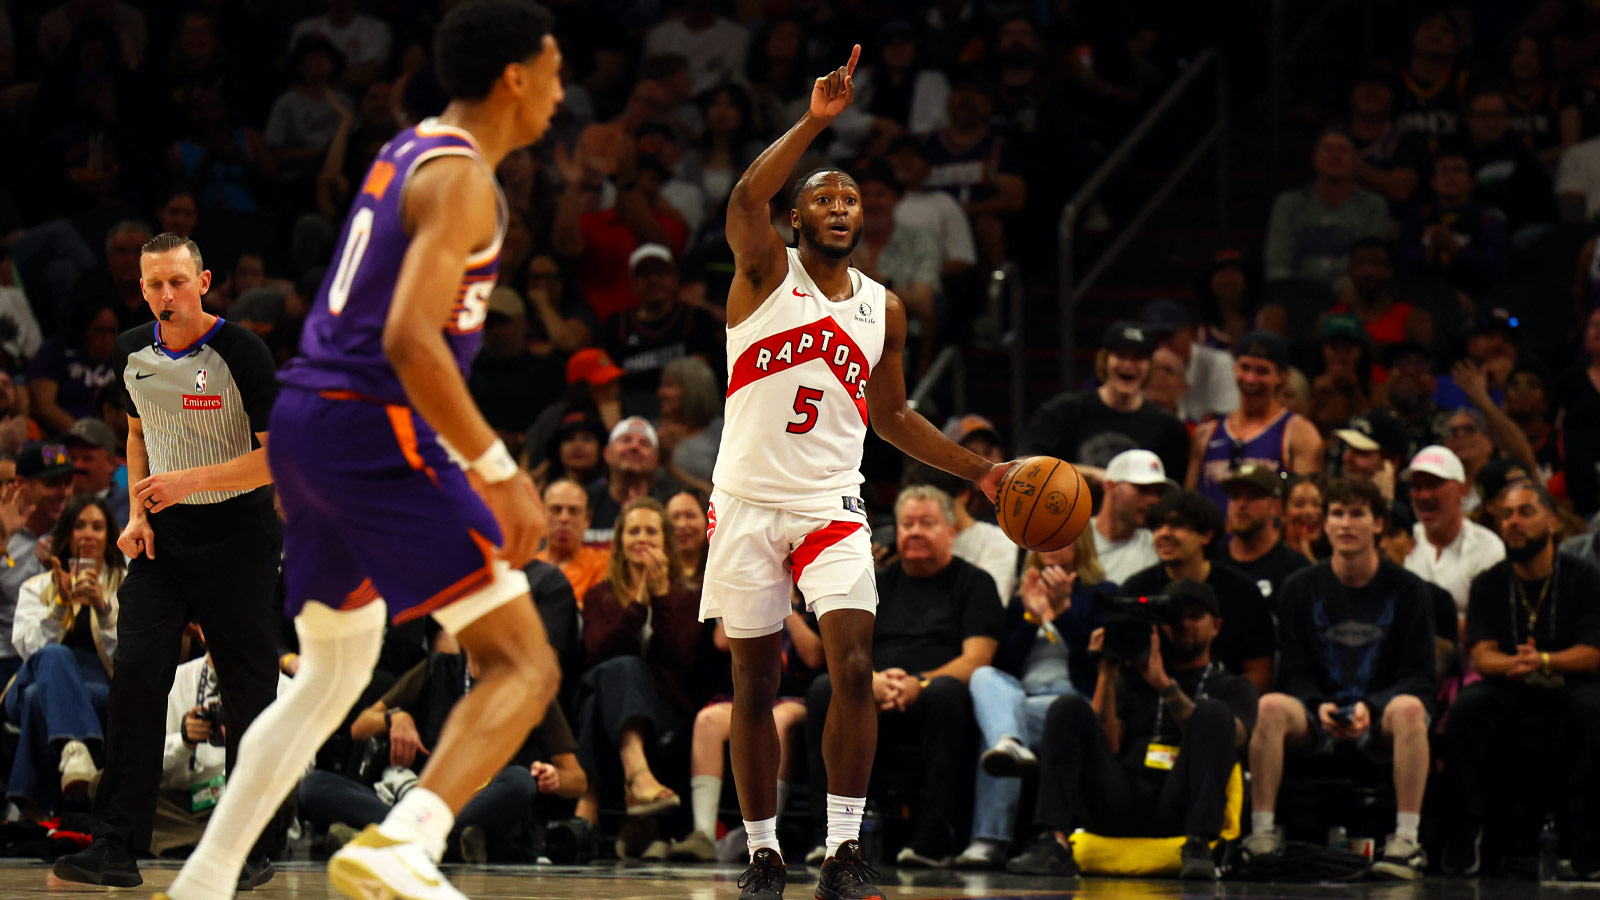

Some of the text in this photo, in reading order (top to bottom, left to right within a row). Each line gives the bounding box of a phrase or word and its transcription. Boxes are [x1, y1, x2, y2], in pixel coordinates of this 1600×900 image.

[328, 206, 374, 316] 0
[864, 317, 876, 325] Life
[756, 329, 867, 401] RAPTORS
[183, 397, 221, 407] Emirates
[785, 385, 824, 435] 5
